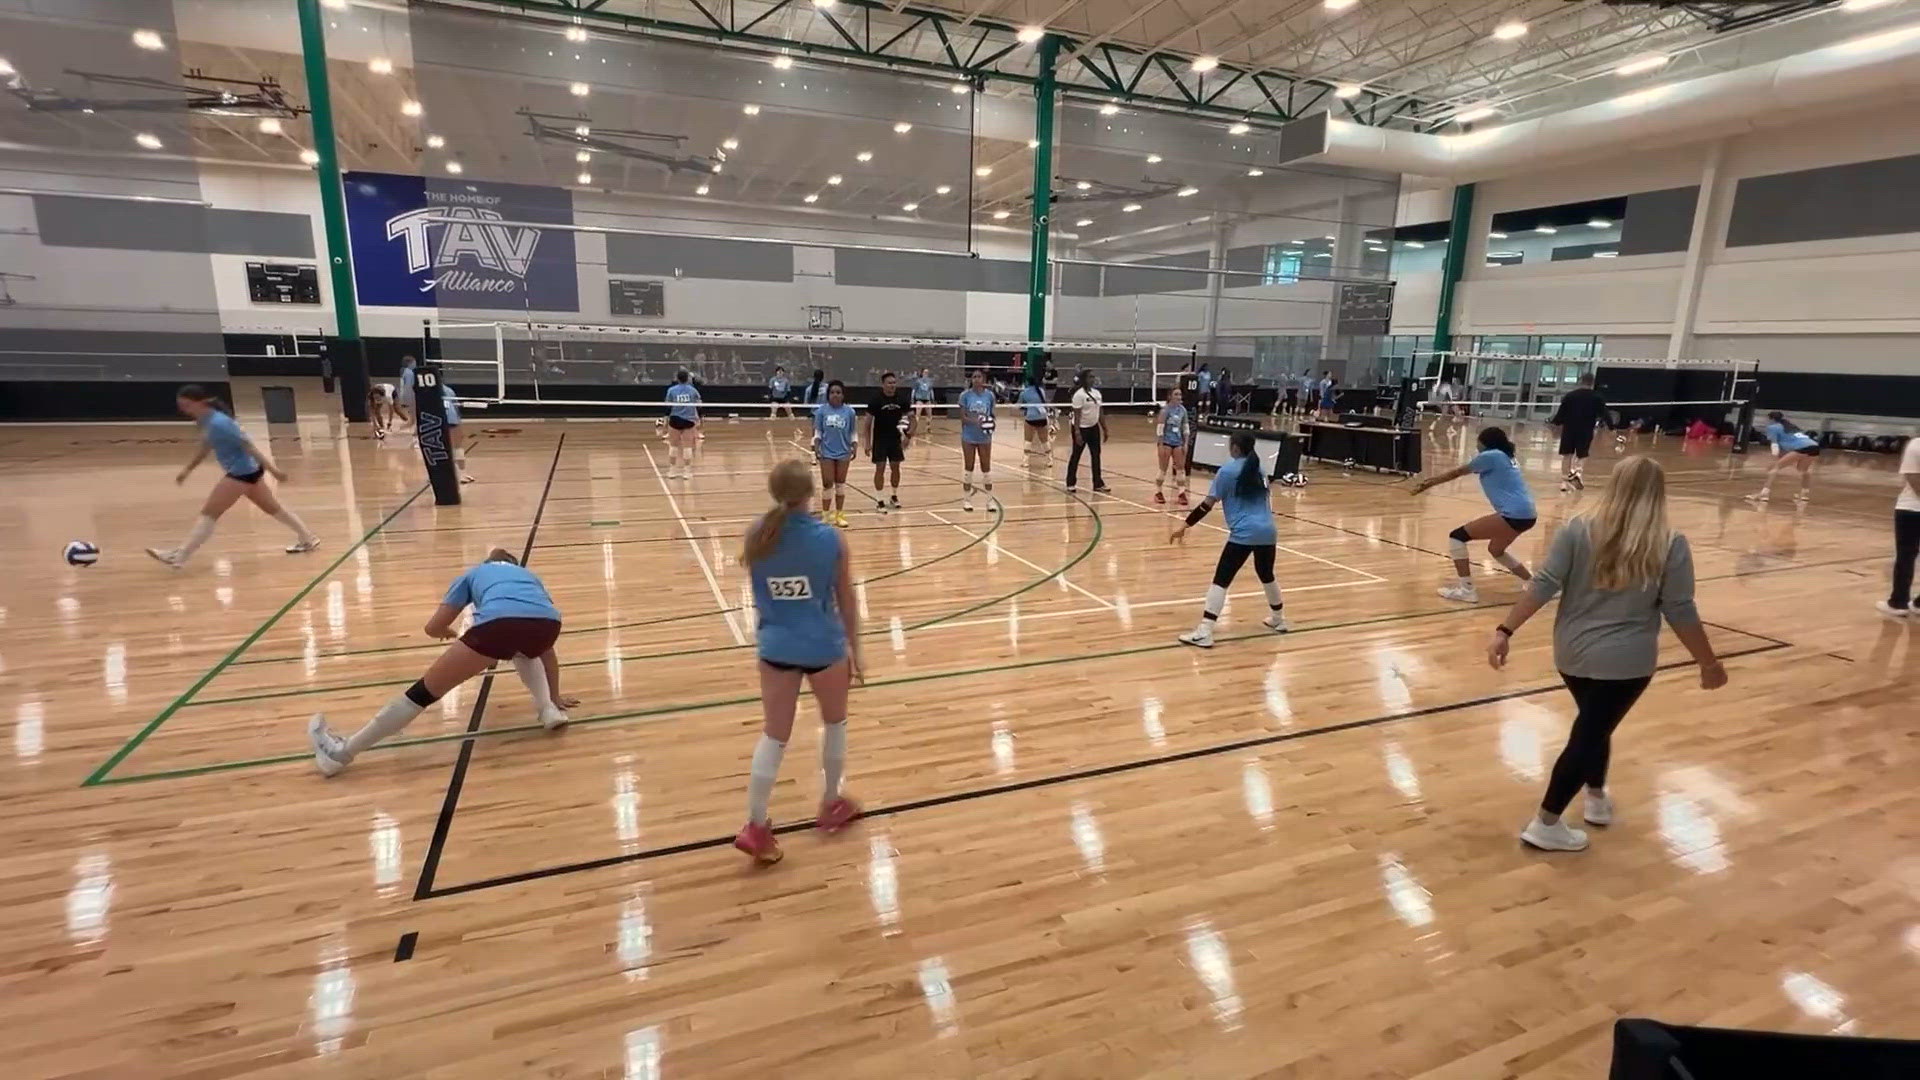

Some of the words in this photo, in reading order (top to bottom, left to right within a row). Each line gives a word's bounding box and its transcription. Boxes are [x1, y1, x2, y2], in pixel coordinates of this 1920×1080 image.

[423, 191, 447, 202] THE
[449, 193, 483, 204] HOME
[486, 196, 502, 205] OF
[386, 206, 541, 278] TAV
[419, 270, 515, 292] Alliance
[417, 373, 437, 387] 10
[1187, 380, 1198, 390] 10
[420, 412, 449, 466] TAV
[770, 580, 810, 597] 352
